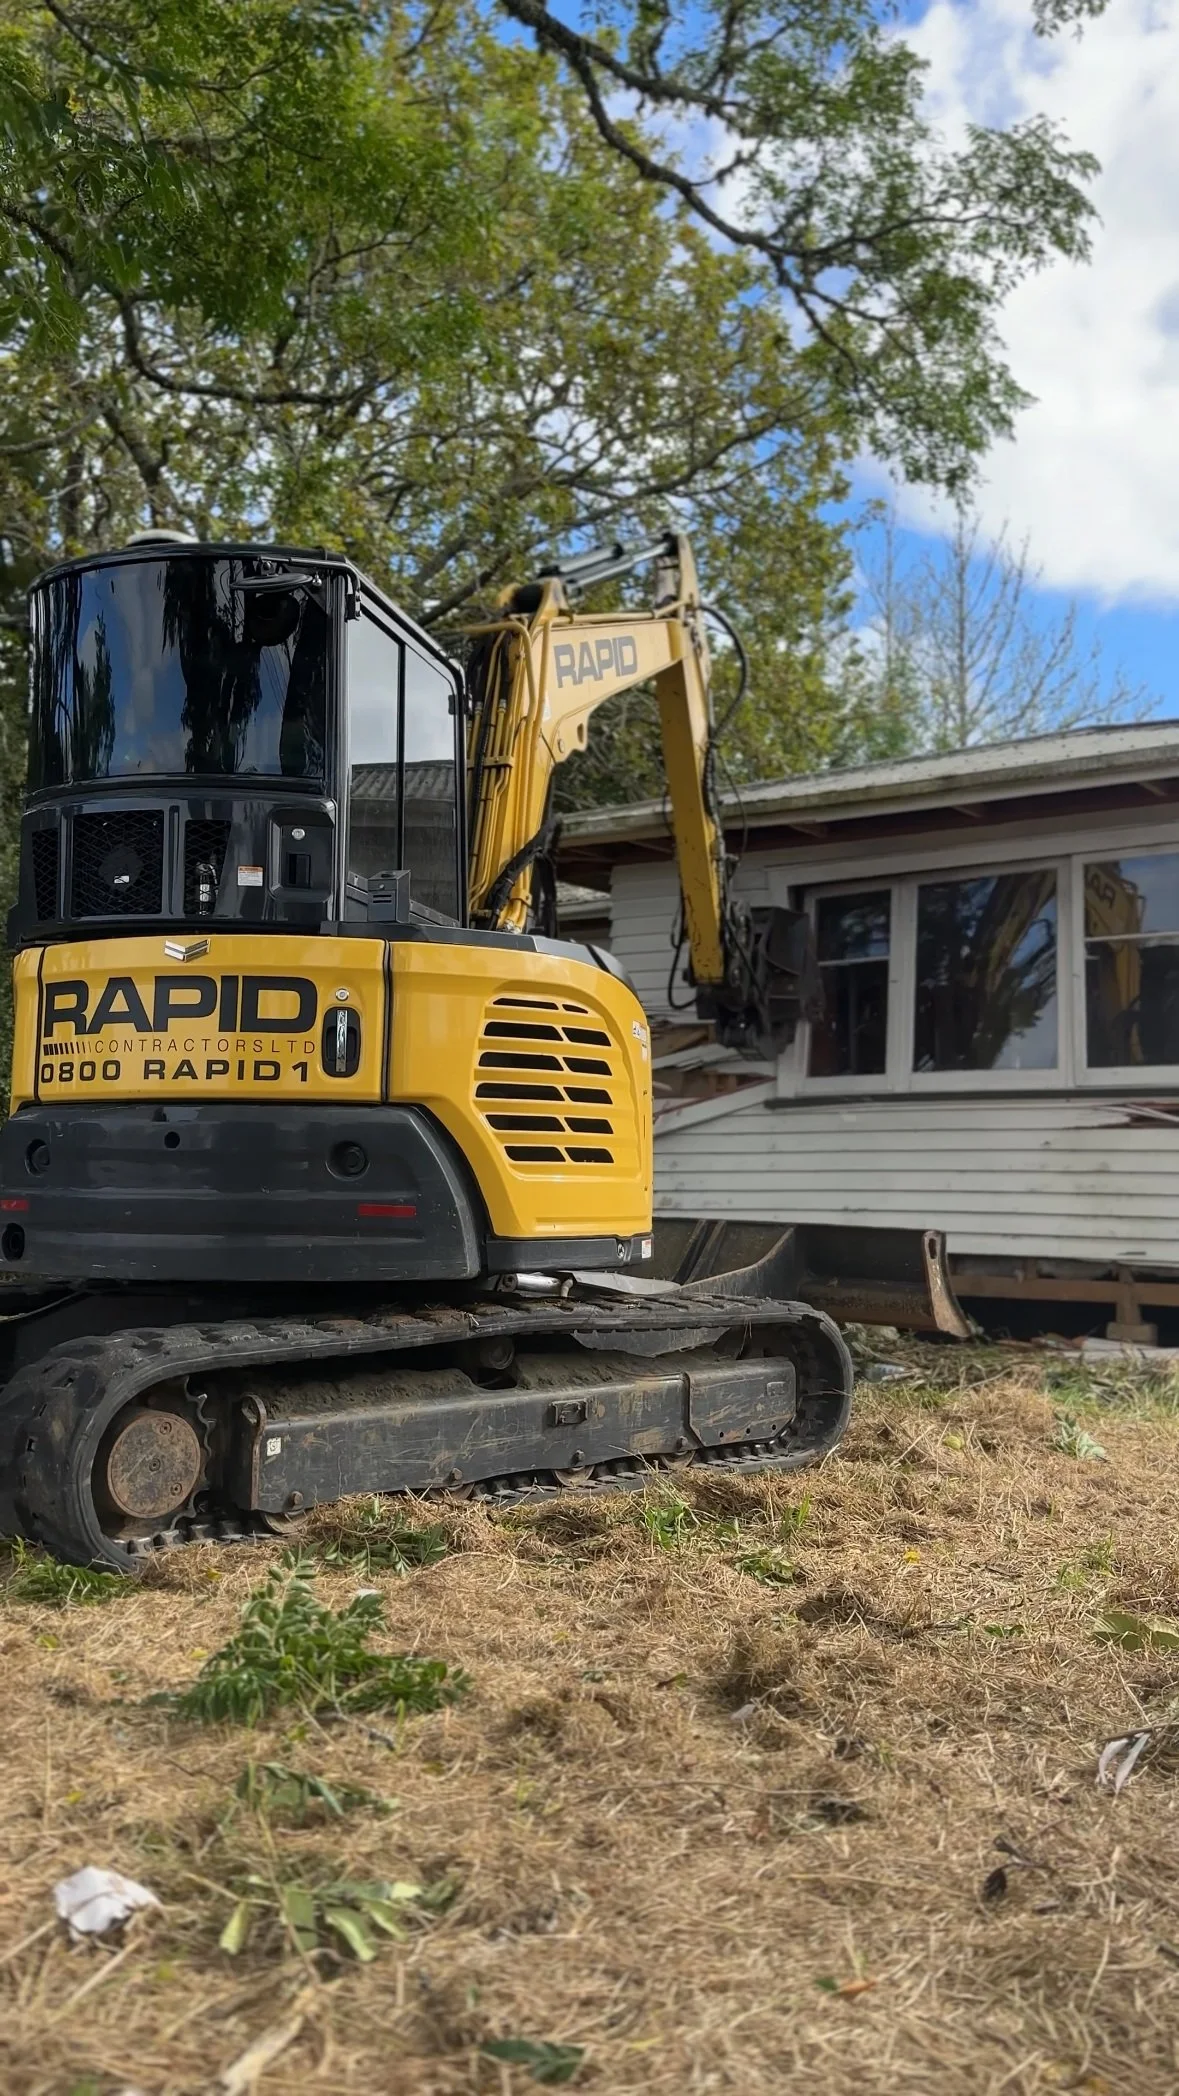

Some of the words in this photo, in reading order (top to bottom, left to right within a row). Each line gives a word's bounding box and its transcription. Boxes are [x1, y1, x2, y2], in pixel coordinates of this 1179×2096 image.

[553, 635, 638, 688] RAPID
[43, 975, 318, 1038] RAPID
[40, 1060, 121, 1083] 0800
